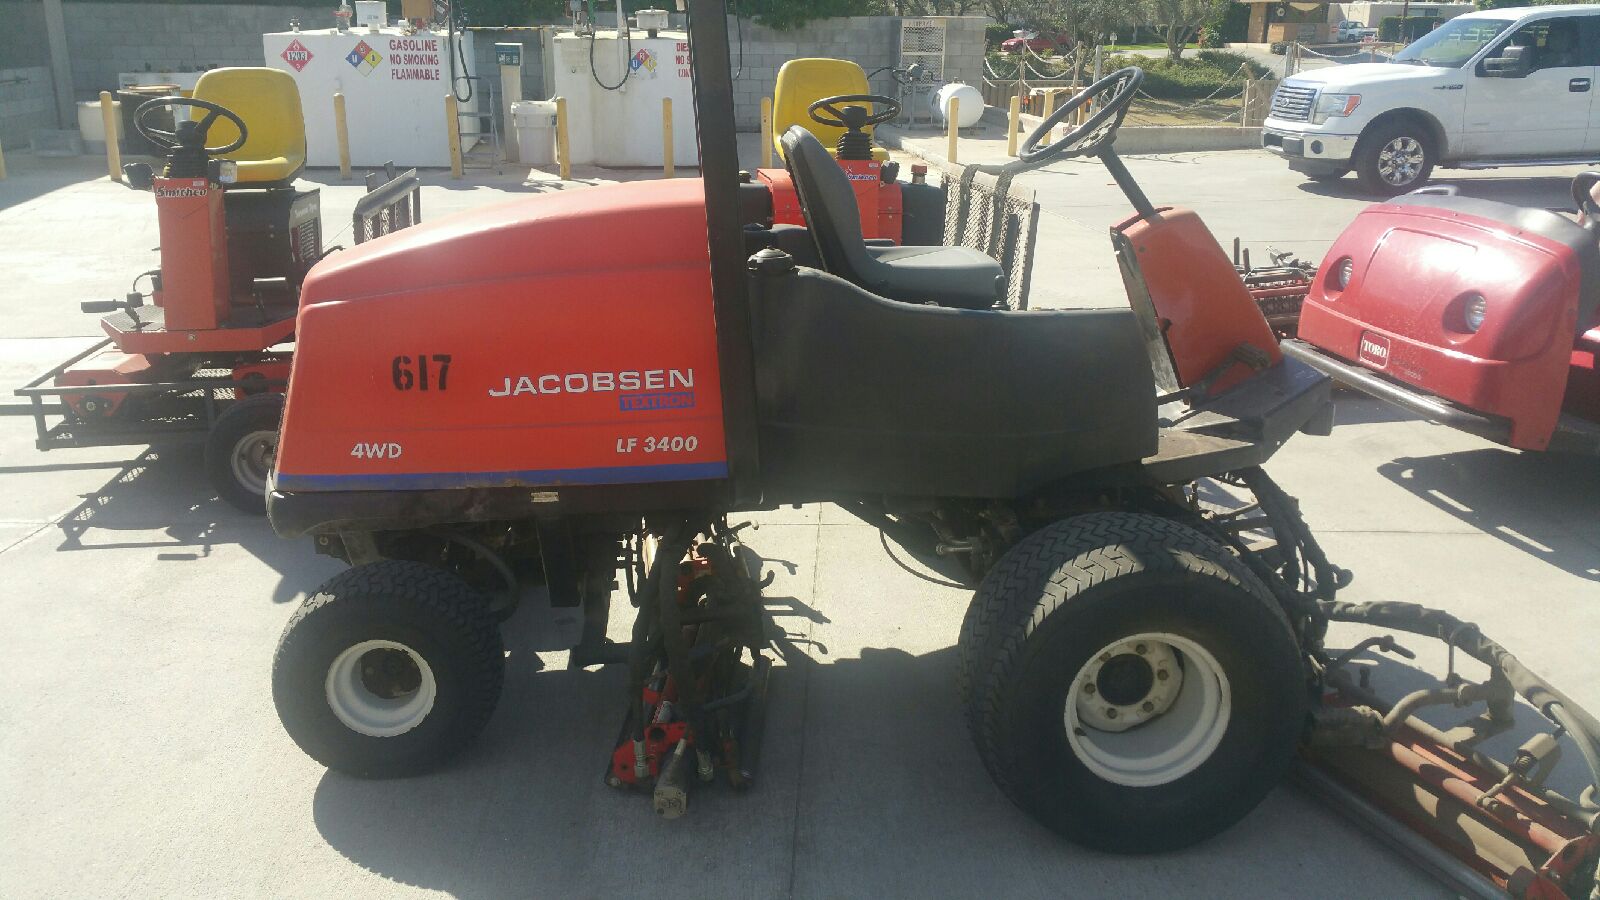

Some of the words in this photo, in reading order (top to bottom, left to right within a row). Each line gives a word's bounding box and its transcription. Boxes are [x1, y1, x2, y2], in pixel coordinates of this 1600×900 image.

[389, 39, 438, 51] GASOLINE
[288, 51, 306, 60] 1203
[390, 54, 401, 65] NO
[403, 54, 439, 65] SMOKING
[676, 55, 684, 64] NO
[391, 68, 440, 80] FLAMMABLE
[1363, 340, 1387, 357] TORO
[392, 354, 452, 391] 617
[488, 368, 694, 397] JACOBSEN
[620, 393, 694, 411] TEXTRON
[350, 442, 402, 459] 4WD
[616, 437, 638, 453] LF
[643, 435, 698, 453] 3400
